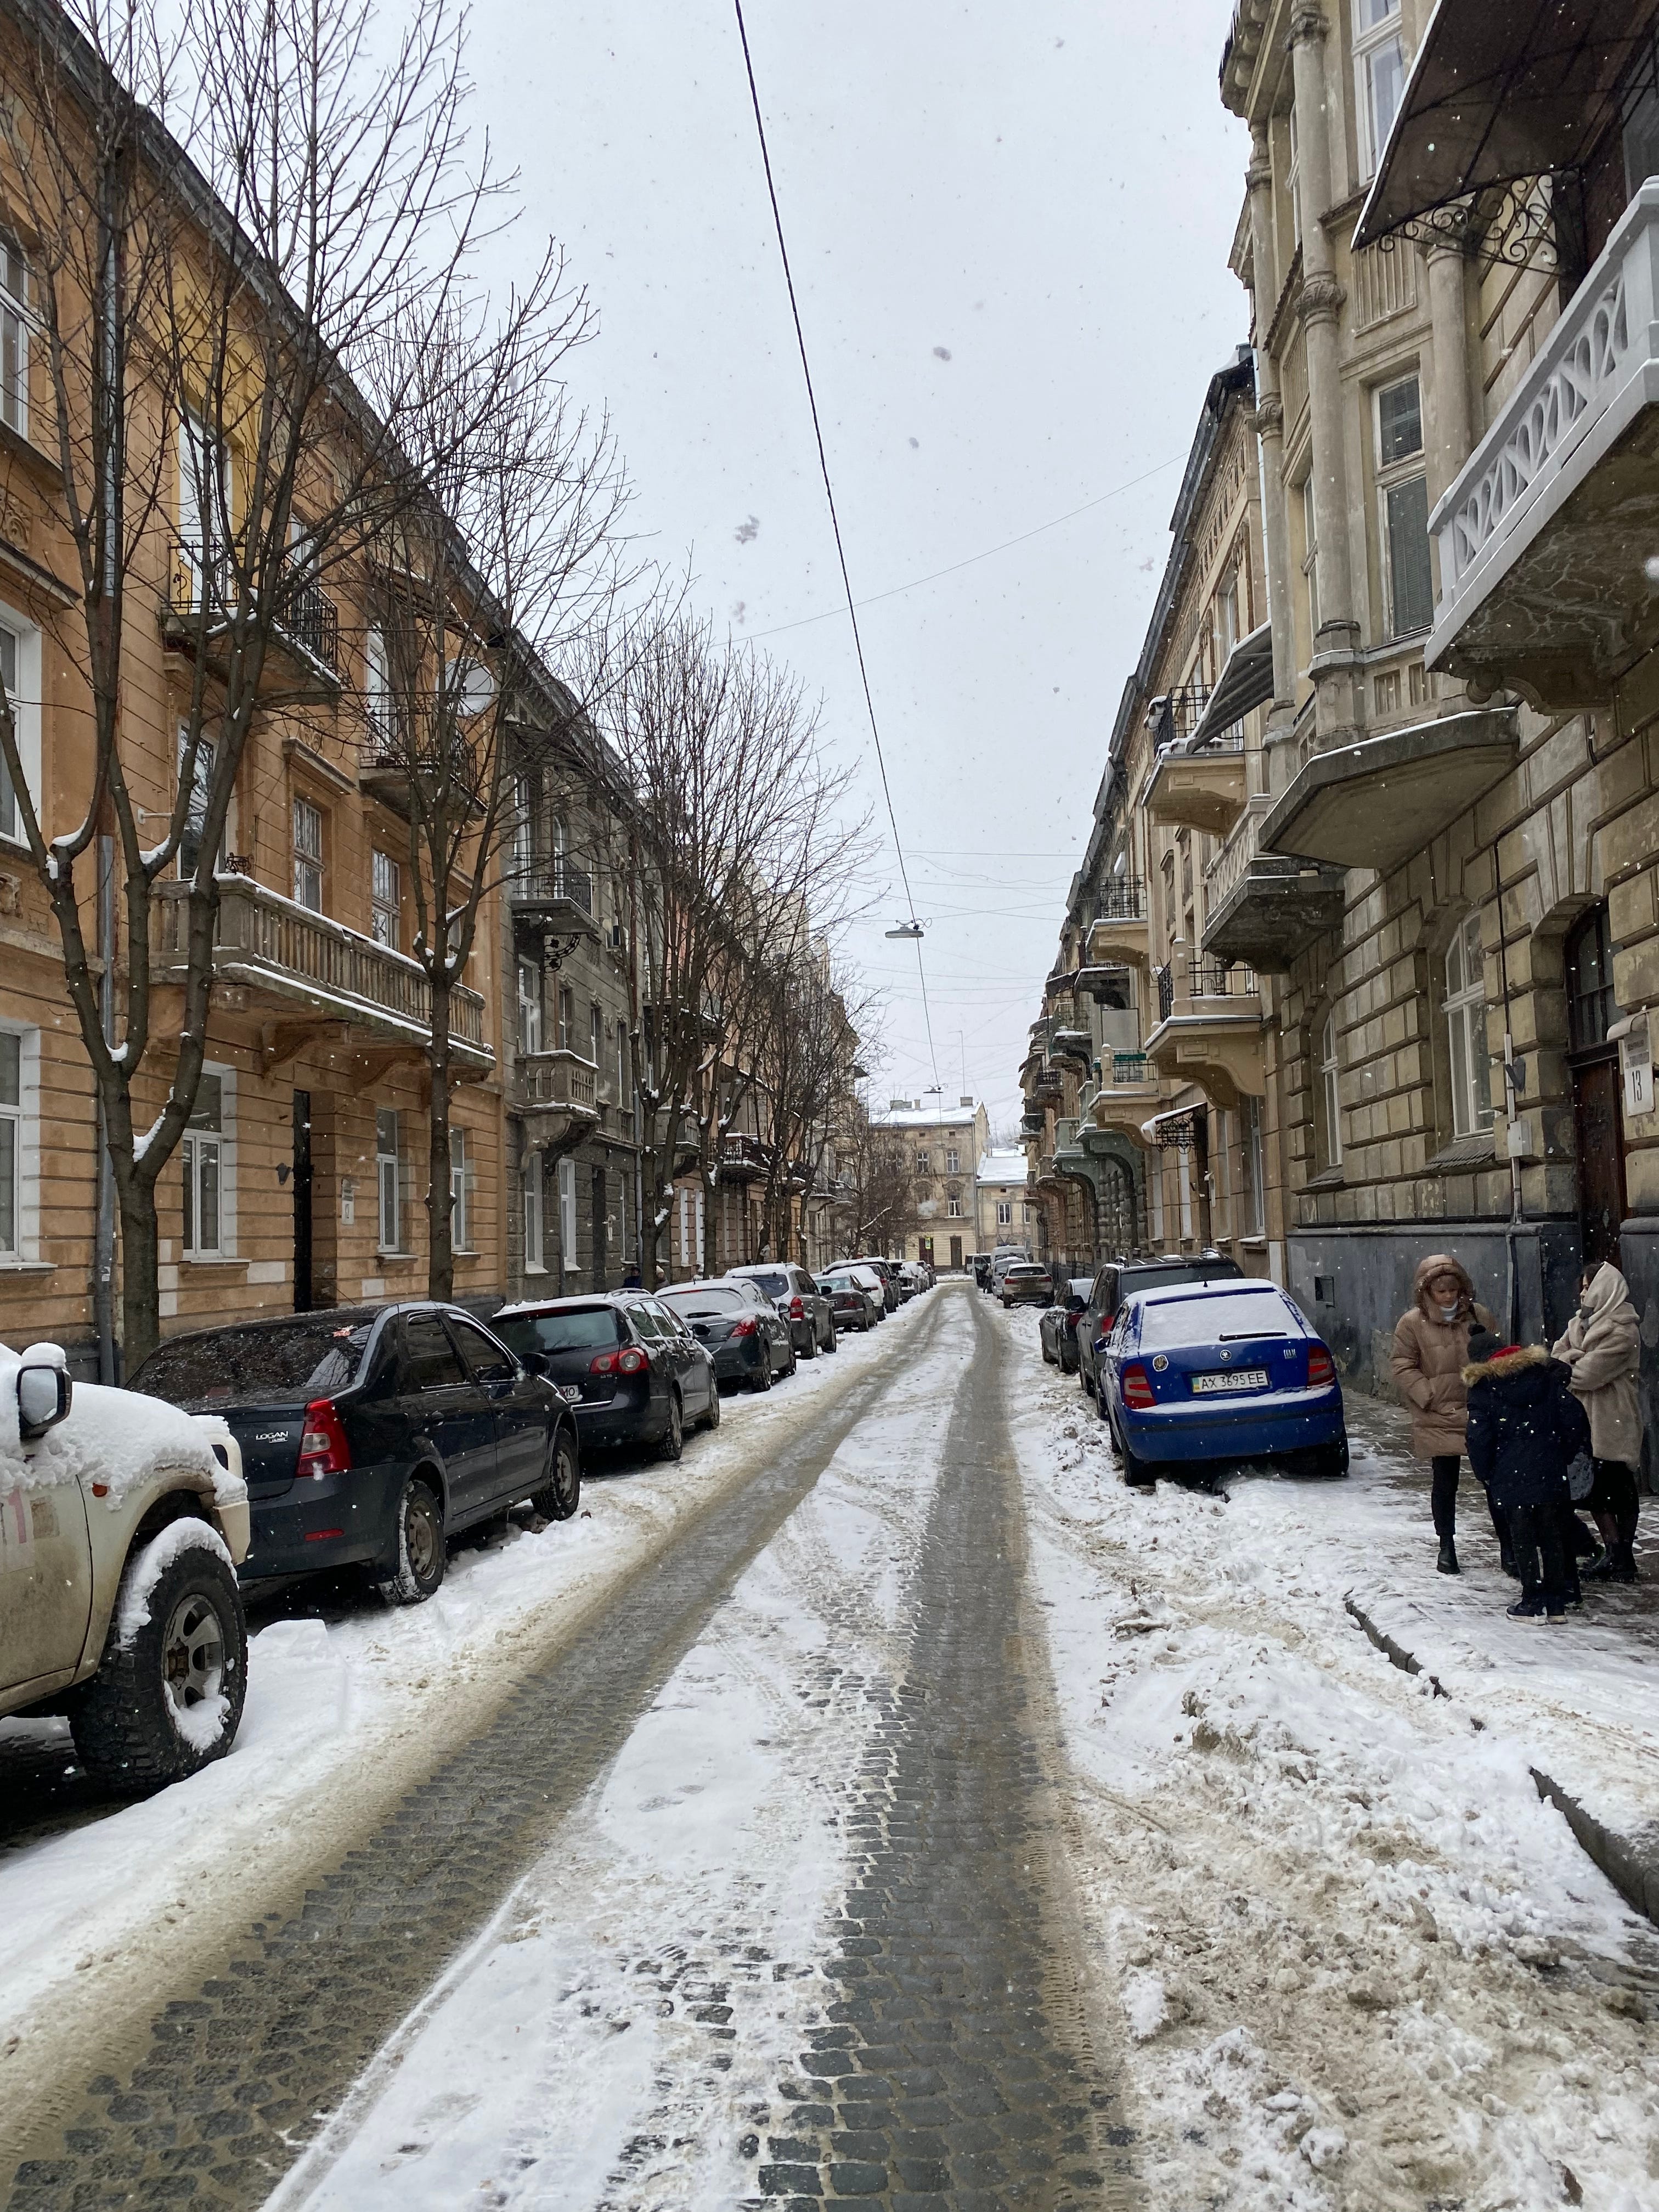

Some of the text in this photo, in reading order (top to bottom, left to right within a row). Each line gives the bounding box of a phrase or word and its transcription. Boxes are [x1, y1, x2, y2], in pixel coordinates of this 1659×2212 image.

[1632, 1070, 1642, 1103] 13
[1201, 1373, 1265, 1389] AX 3695 EE
[255, 1431, 289, 1440] LOGAN
